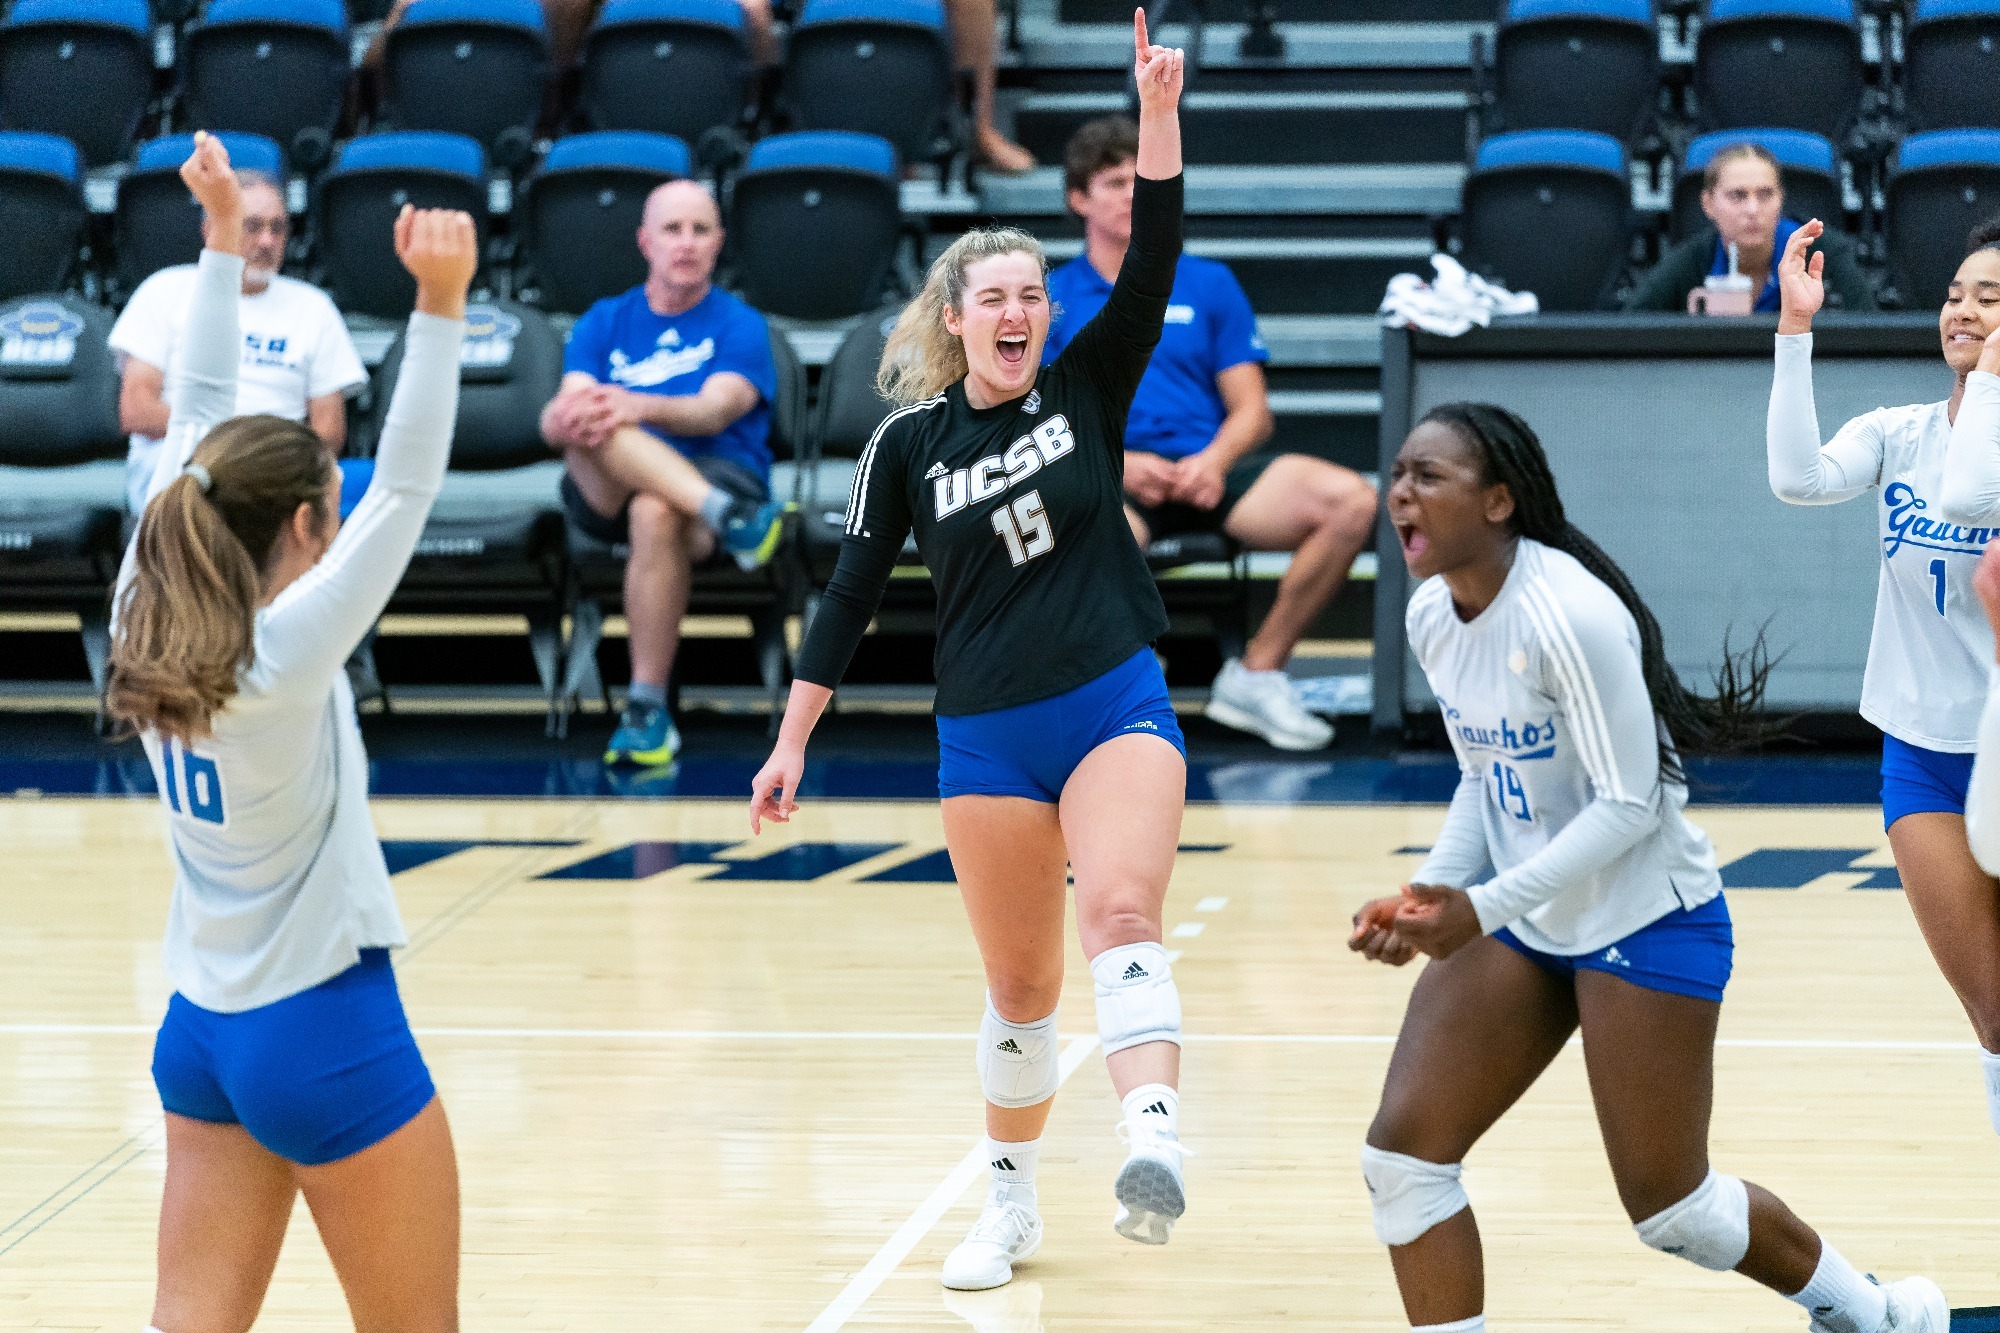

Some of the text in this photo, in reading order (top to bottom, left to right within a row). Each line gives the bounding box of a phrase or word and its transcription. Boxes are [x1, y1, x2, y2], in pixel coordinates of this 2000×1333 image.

[934, 413, 1076, 522] UCSB
[990, 489, 1055, 568] 15
[1884, 481, 2000, 559] Gauch
[1929, 558, 1946, 617] 1
[160, 735, 226, 826] 16
[1492, 760, 1533, 822] 19
